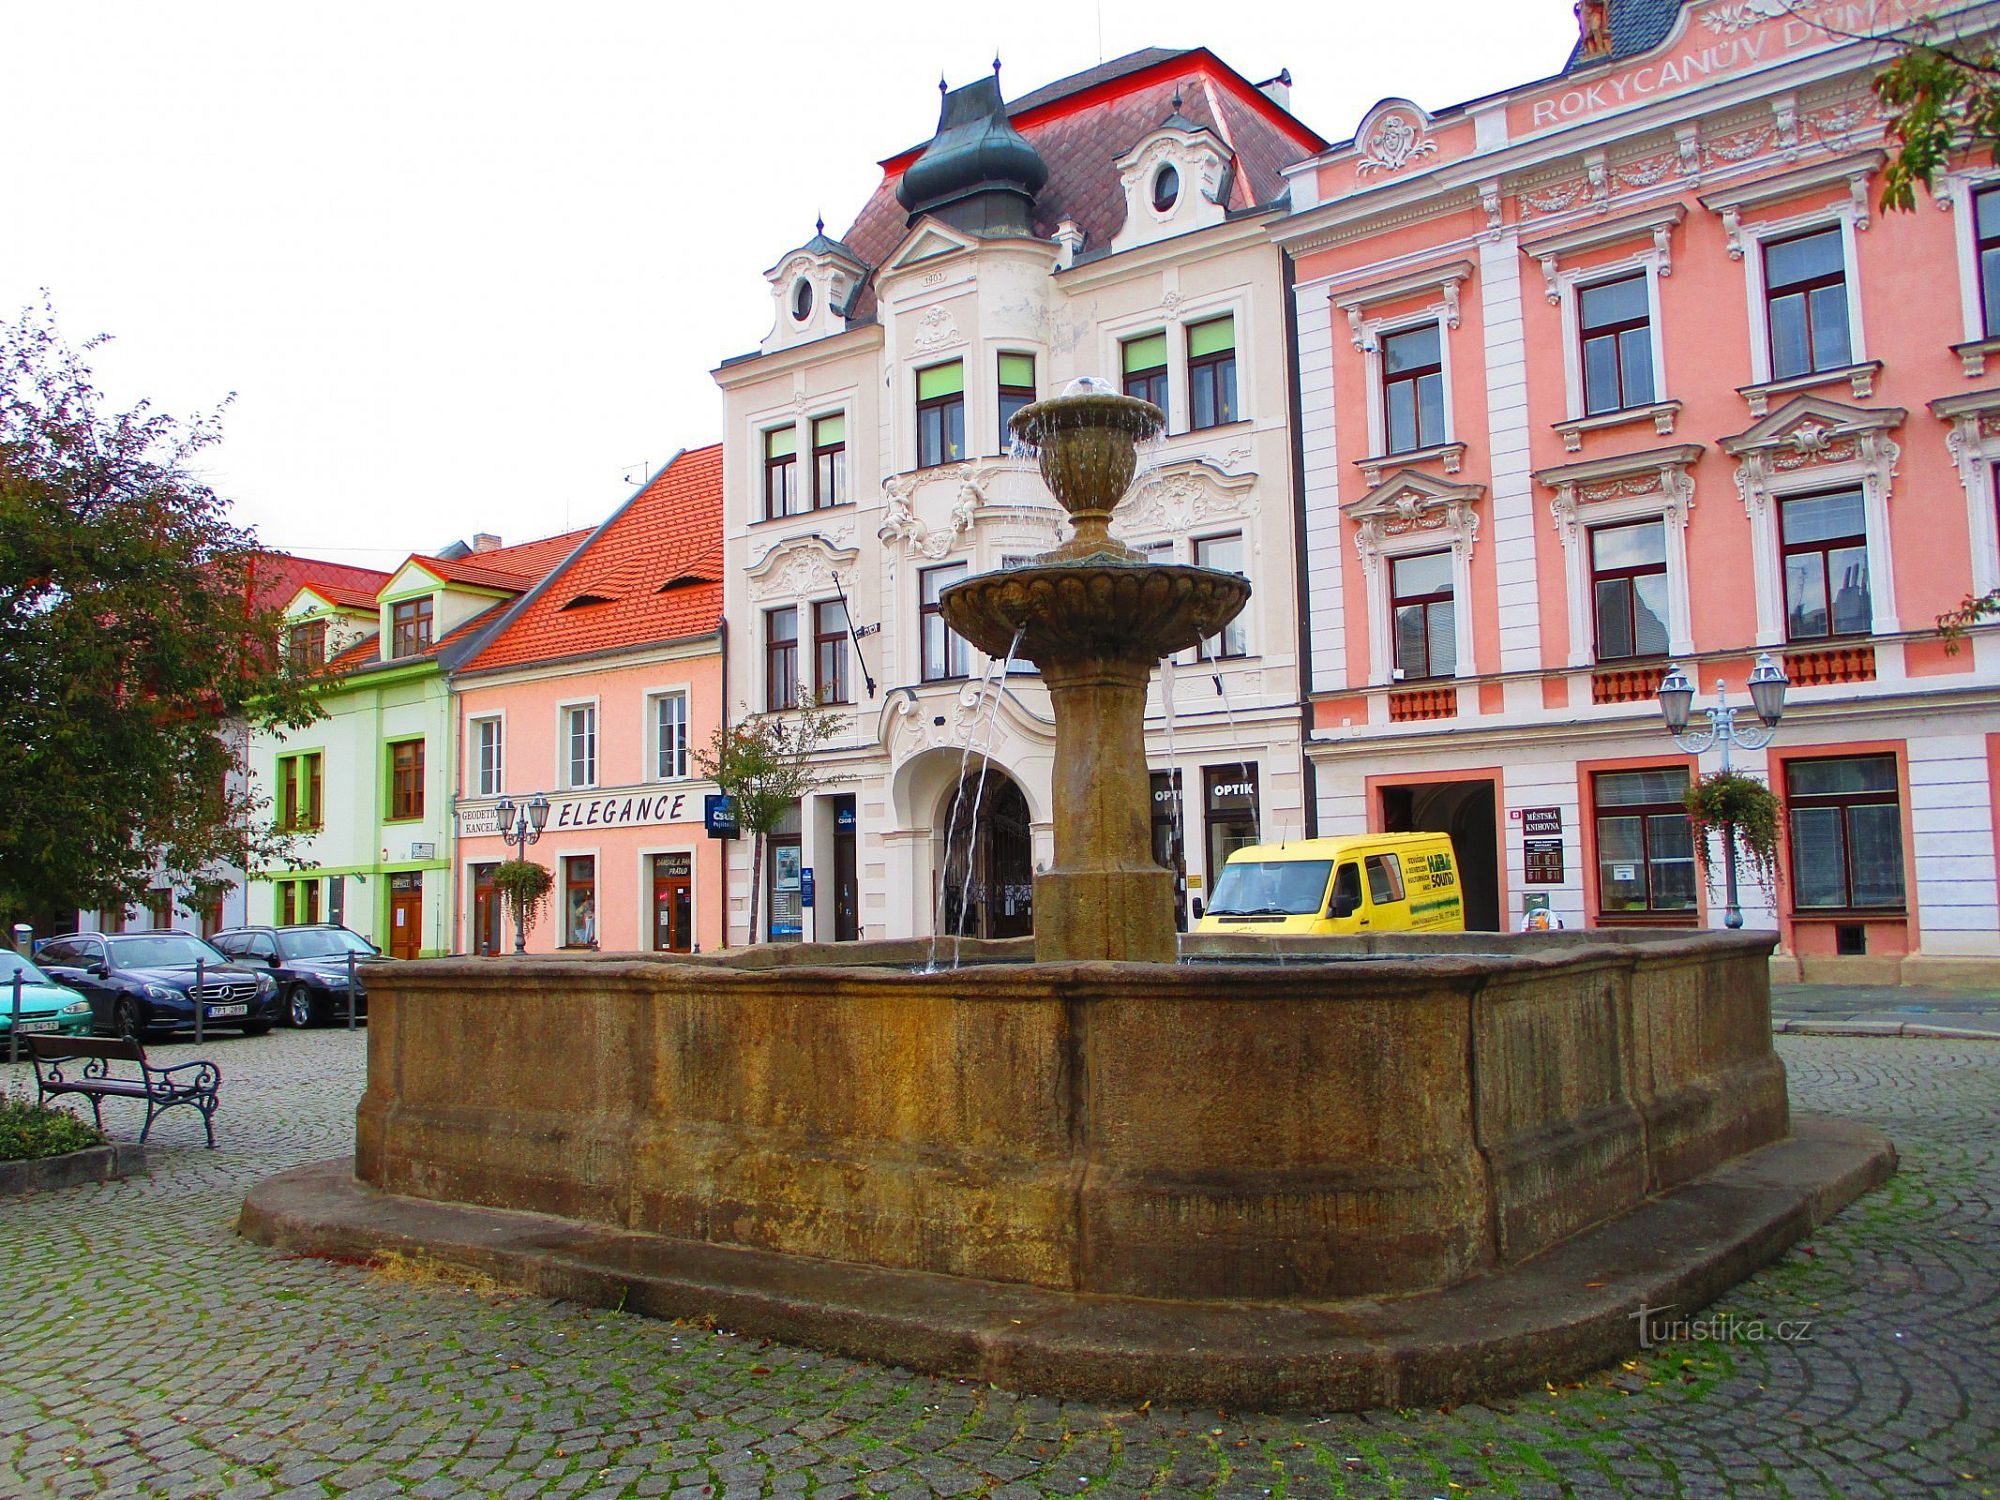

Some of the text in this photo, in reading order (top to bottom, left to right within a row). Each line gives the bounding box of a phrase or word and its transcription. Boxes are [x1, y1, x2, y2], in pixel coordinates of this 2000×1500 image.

[1532, 31, 1768, 127] ROKYCANŮV
[1154, 790, 1182, 801] OPTI
[1214, 784, 1254, 796] OPTIK
[462, 808, 500, 820] GEODETIC
[558, 794, 686, 827] ELEGANCE
[1526, 810, 1557, 821] MĚSTSKÁ
[1525, 823, 1560, 832] KNIHOVNA
[1431, 872, 1454, 888] SOUND
